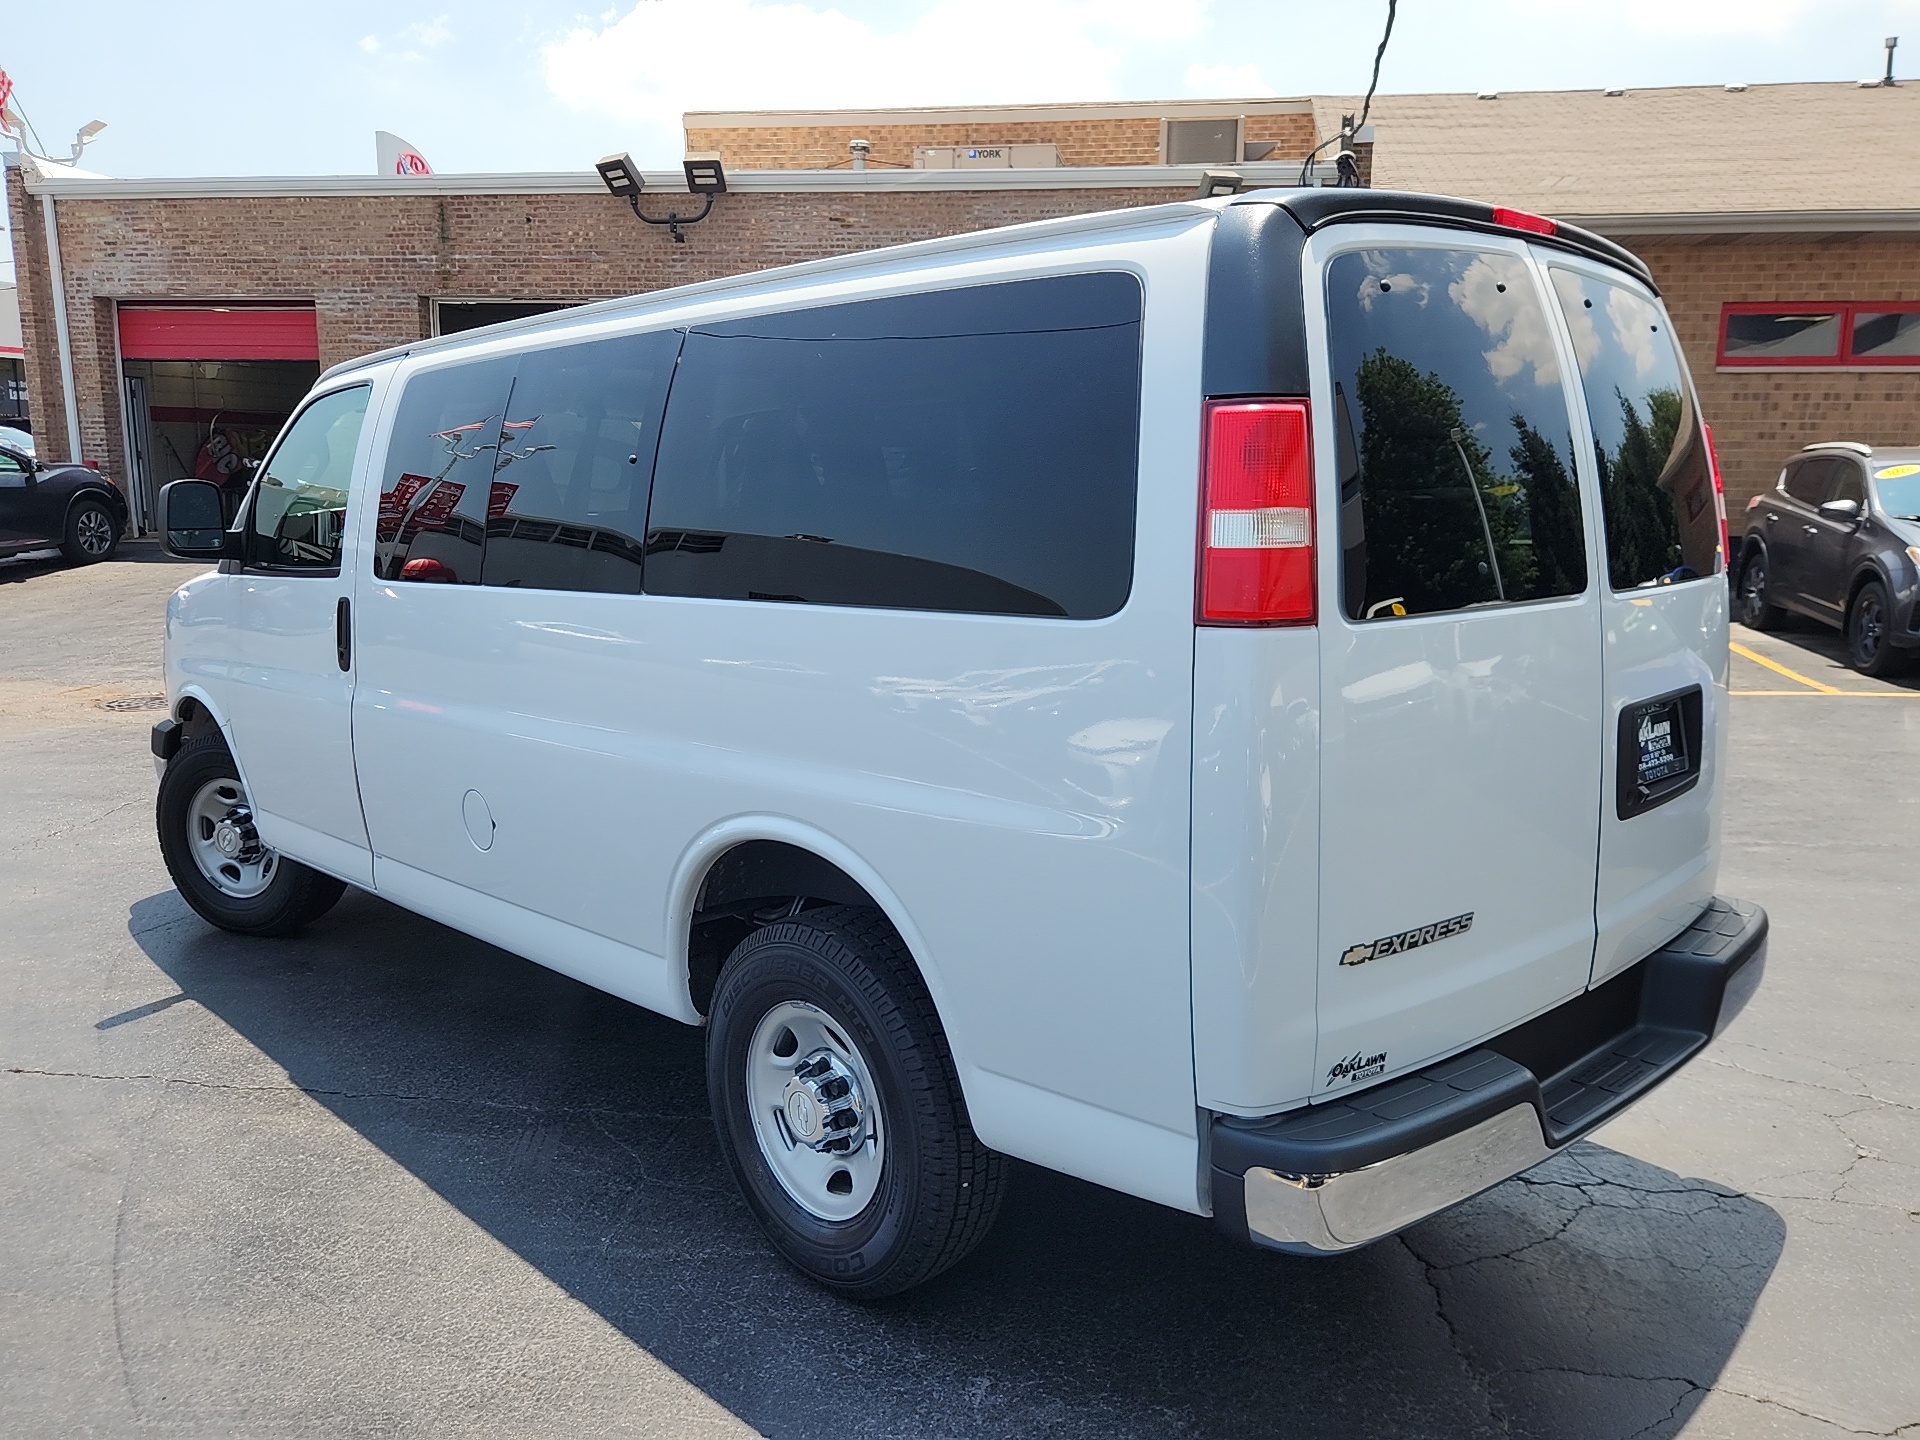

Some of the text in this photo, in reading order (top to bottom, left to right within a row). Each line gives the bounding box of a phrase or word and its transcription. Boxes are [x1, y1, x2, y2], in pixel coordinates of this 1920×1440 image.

[977, 150, 1001, 158] YORK
[1645, 766, 1668, 780] TOYOTA
[1373, 913, 1473, 959] EXPRESS
[720, 955, 875, 1045] DISCOVERER HT3
